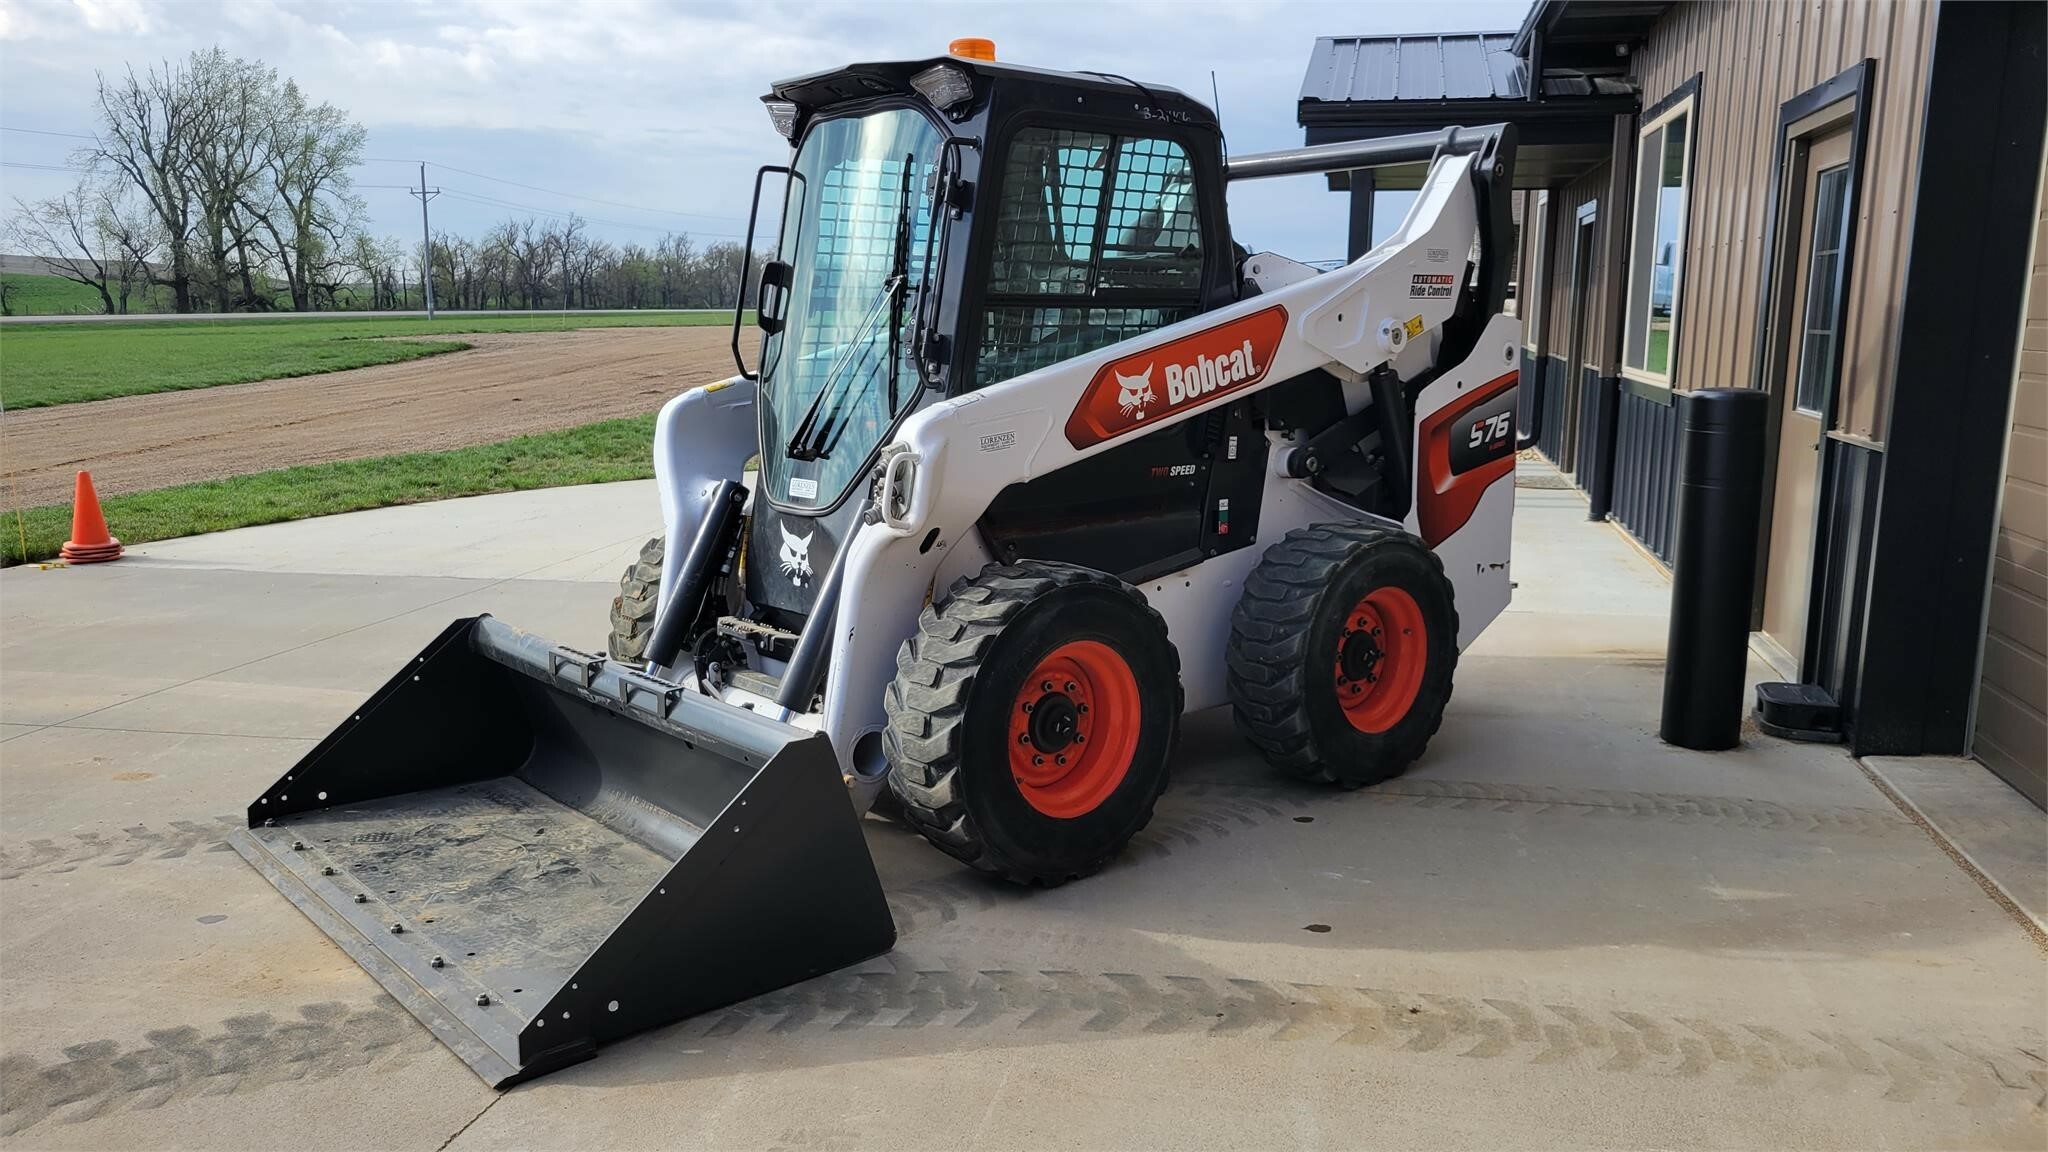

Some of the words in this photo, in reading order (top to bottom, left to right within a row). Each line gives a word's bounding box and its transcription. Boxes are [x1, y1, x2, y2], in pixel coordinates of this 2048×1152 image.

[1412, 275, 1453, 284] AUTOMATIC
[1409, 285, 1425, 296] Ride
[1427, 285, 1452, 296] Control
[1164, 339, 1256, 406] Bobcat
[1469, 411, 1511, 449] S76
[980, 432, 1015, 445] LORENZEN
[1151, 467, 1169, 476] TWO
[1170, 464, 1196, 476] SPEED
